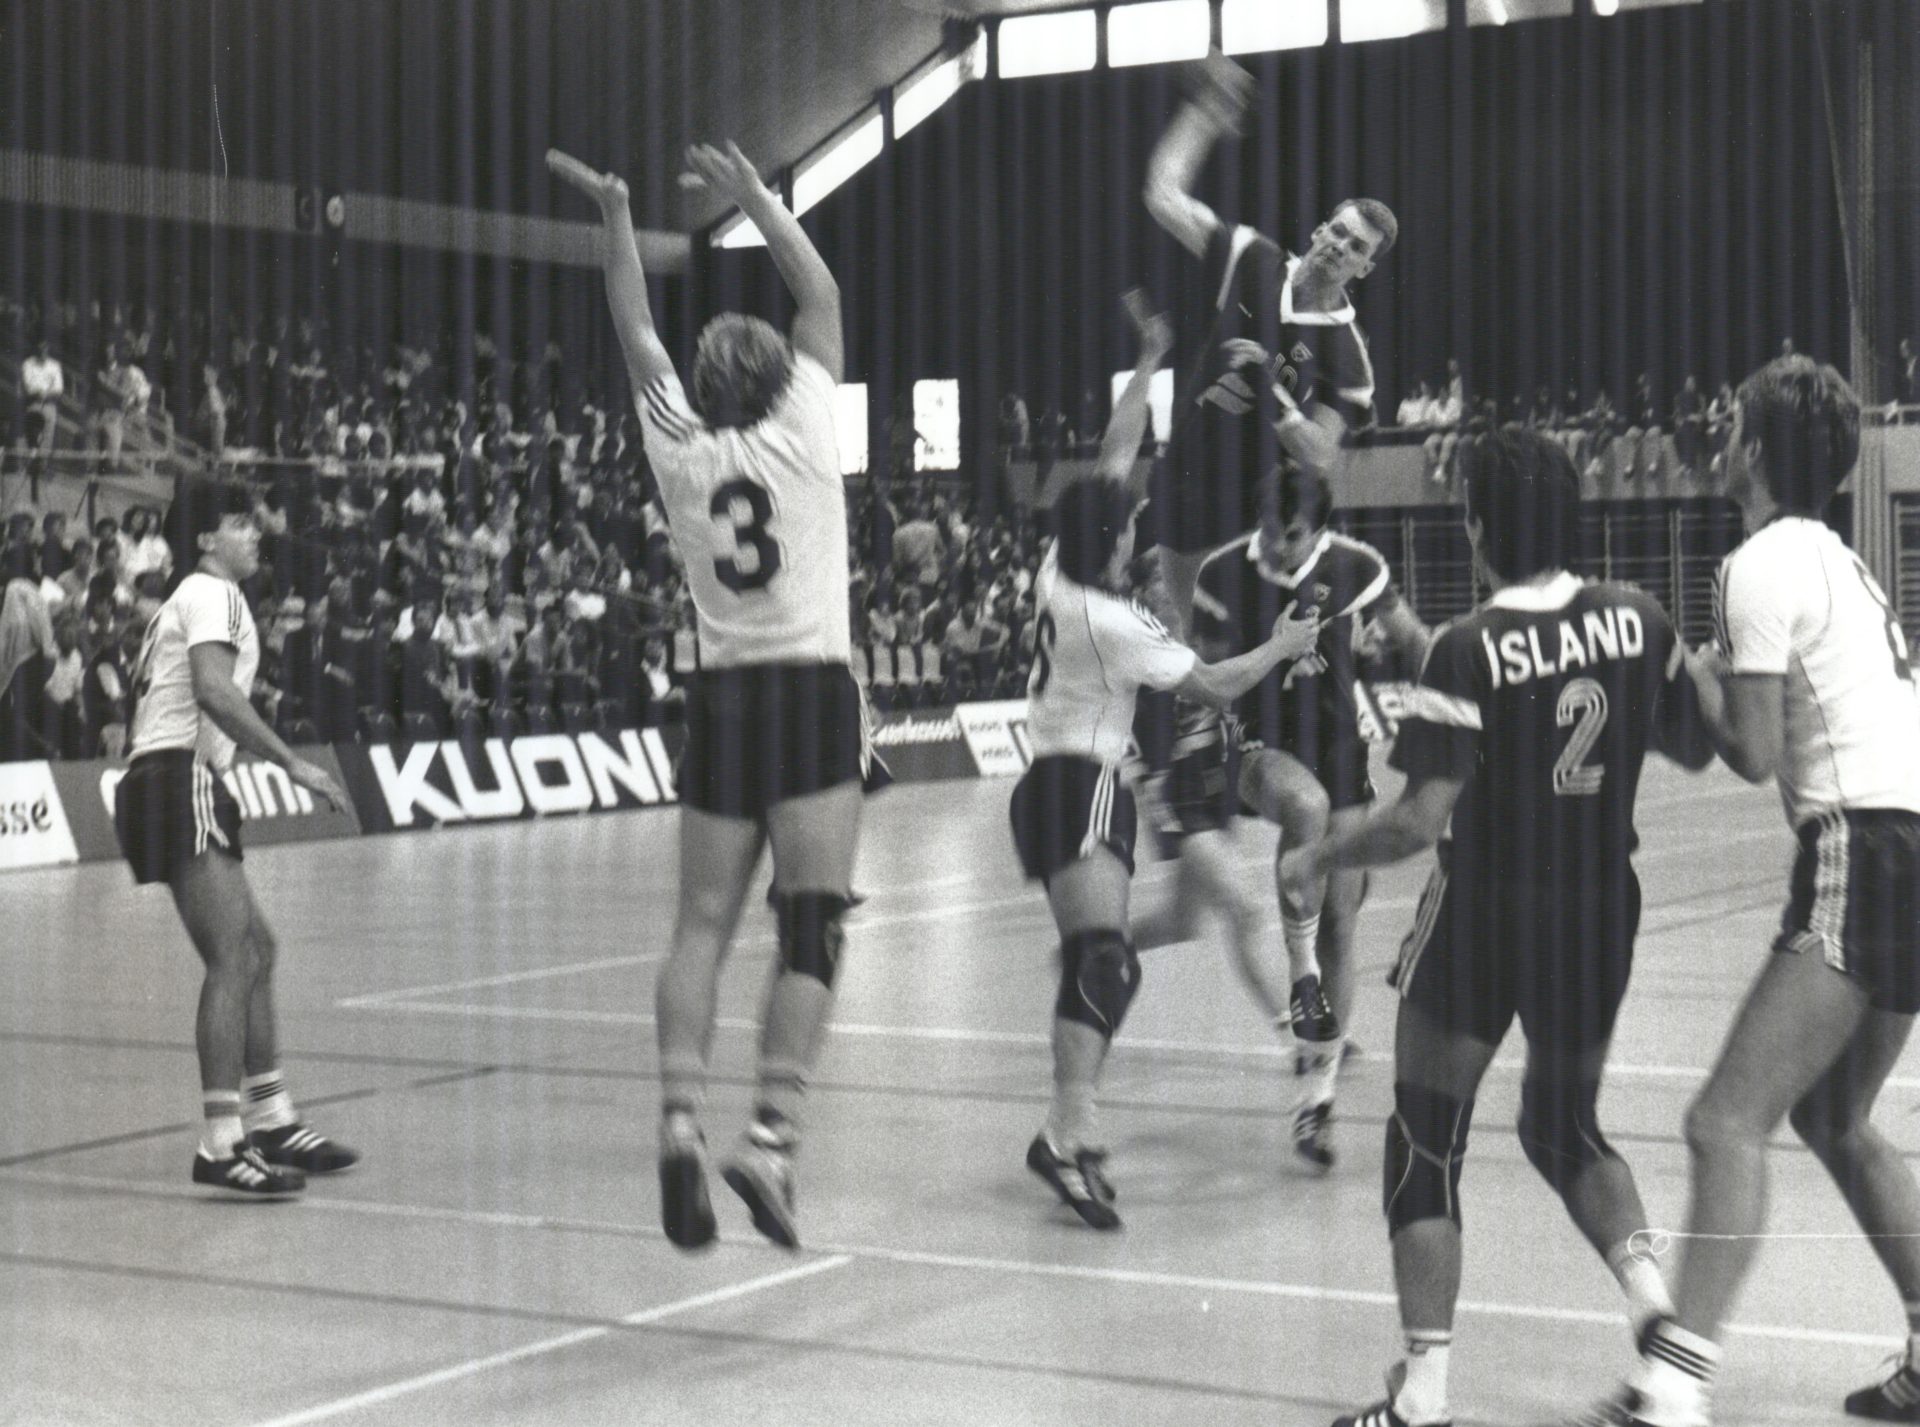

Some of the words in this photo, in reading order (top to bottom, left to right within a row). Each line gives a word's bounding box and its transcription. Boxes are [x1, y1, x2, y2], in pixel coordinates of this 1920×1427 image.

[709, 476, 783, 595] 3
[1481, 606, 1645, 690] ISLAND
[368, 727, 679, 826] KUONI
[1553, 676, 1609, 796] 2
